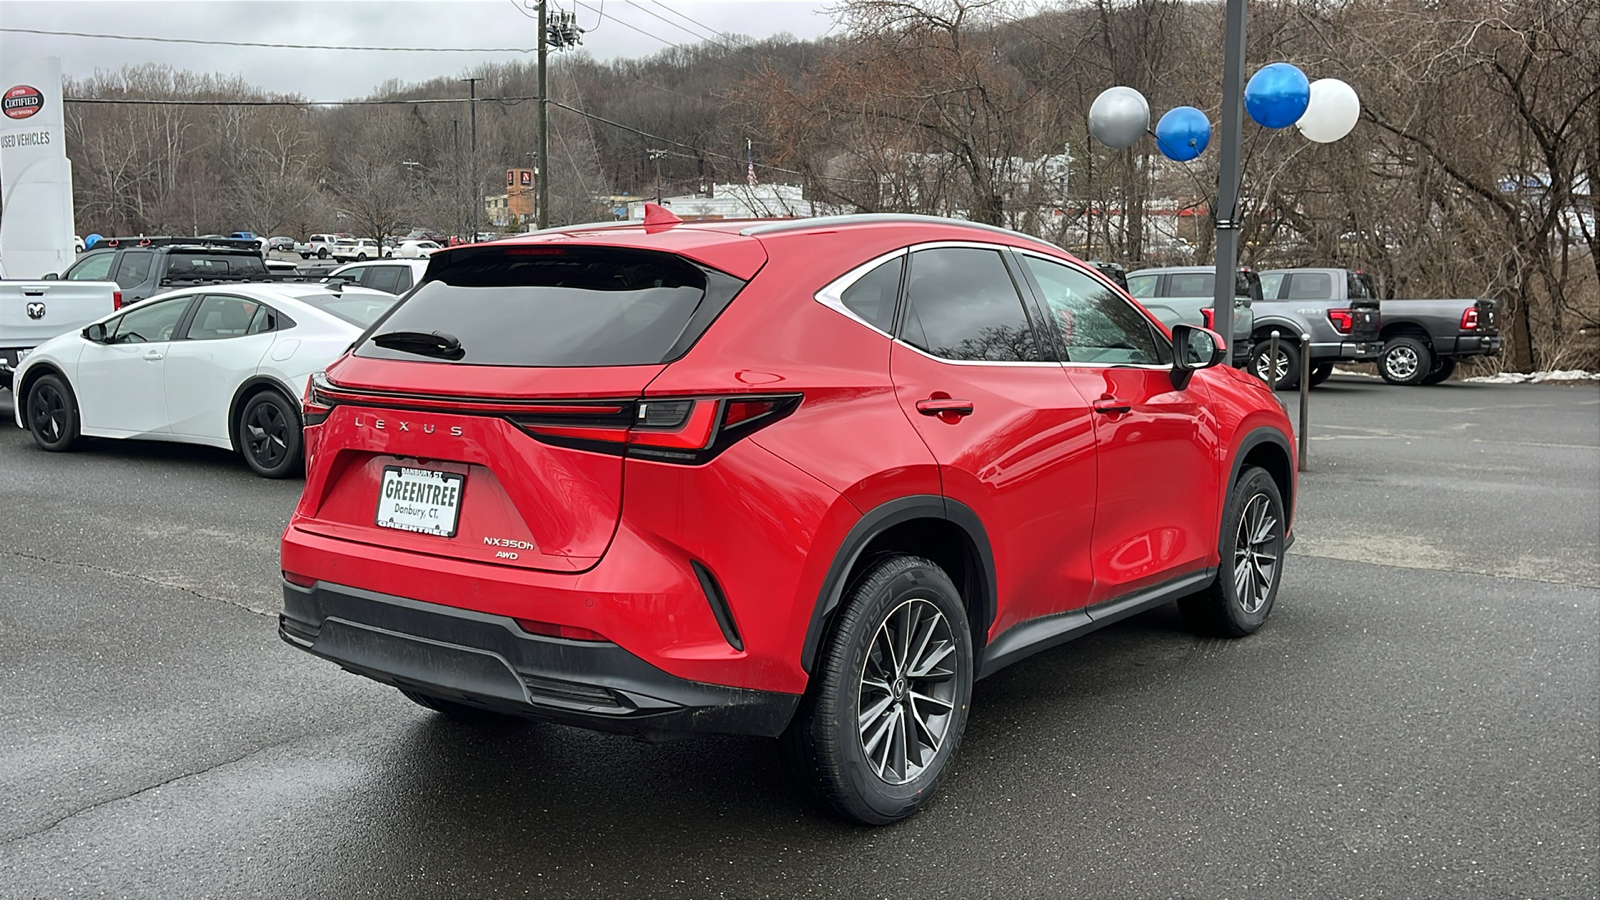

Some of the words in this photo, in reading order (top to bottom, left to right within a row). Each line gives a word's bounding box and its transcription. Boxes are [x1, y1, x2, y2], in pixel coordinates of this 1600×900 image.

[5, 97, 38, 108] CERTIFIED
[1, 134, 15, 148] USED
[17, 131, 50, 146] VEHICLES
[355, 417, 462, 436] LEXUS
[385, 479, 457, 507] GREENTREE
[394, 503, 427, 520] Danbury,
[377, 520, 449, 537] GREENTREE
[495, 551, 519, 560] AWD
